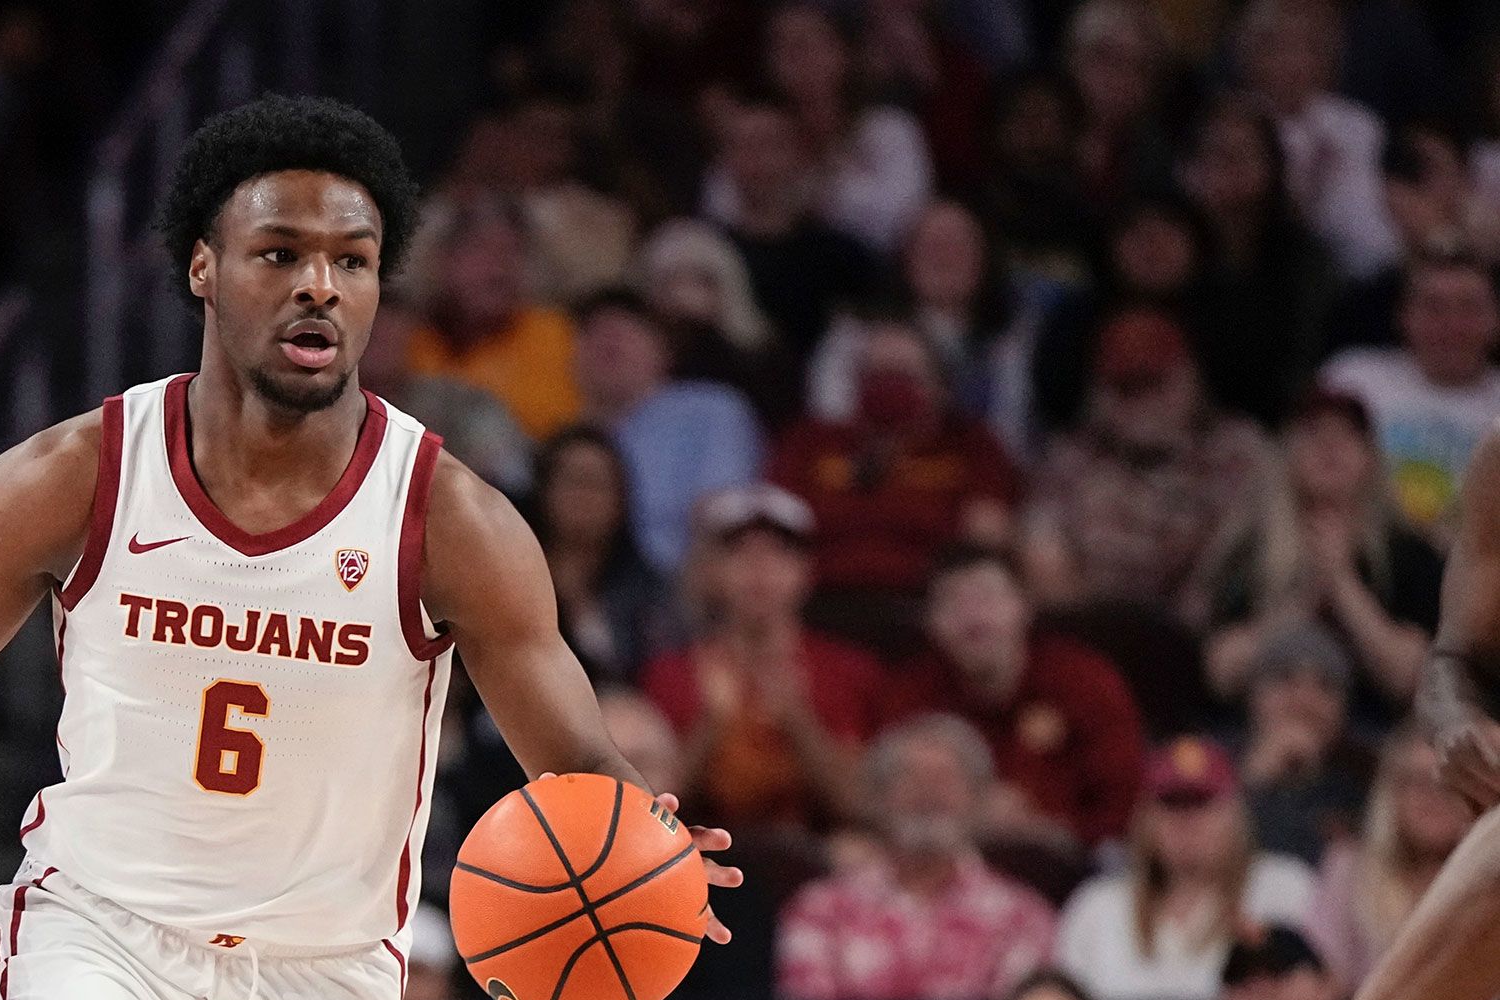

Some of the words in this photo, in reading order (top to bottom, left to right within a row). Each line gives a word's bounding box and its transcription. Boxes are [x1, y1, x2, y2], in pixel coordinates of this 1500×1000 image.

[338, 550, 368, 575] PAC
[343, 566, 360, 582] 12
[119, 592, 373, 667] TROJANS
[193, 677, 271, 798] 6
